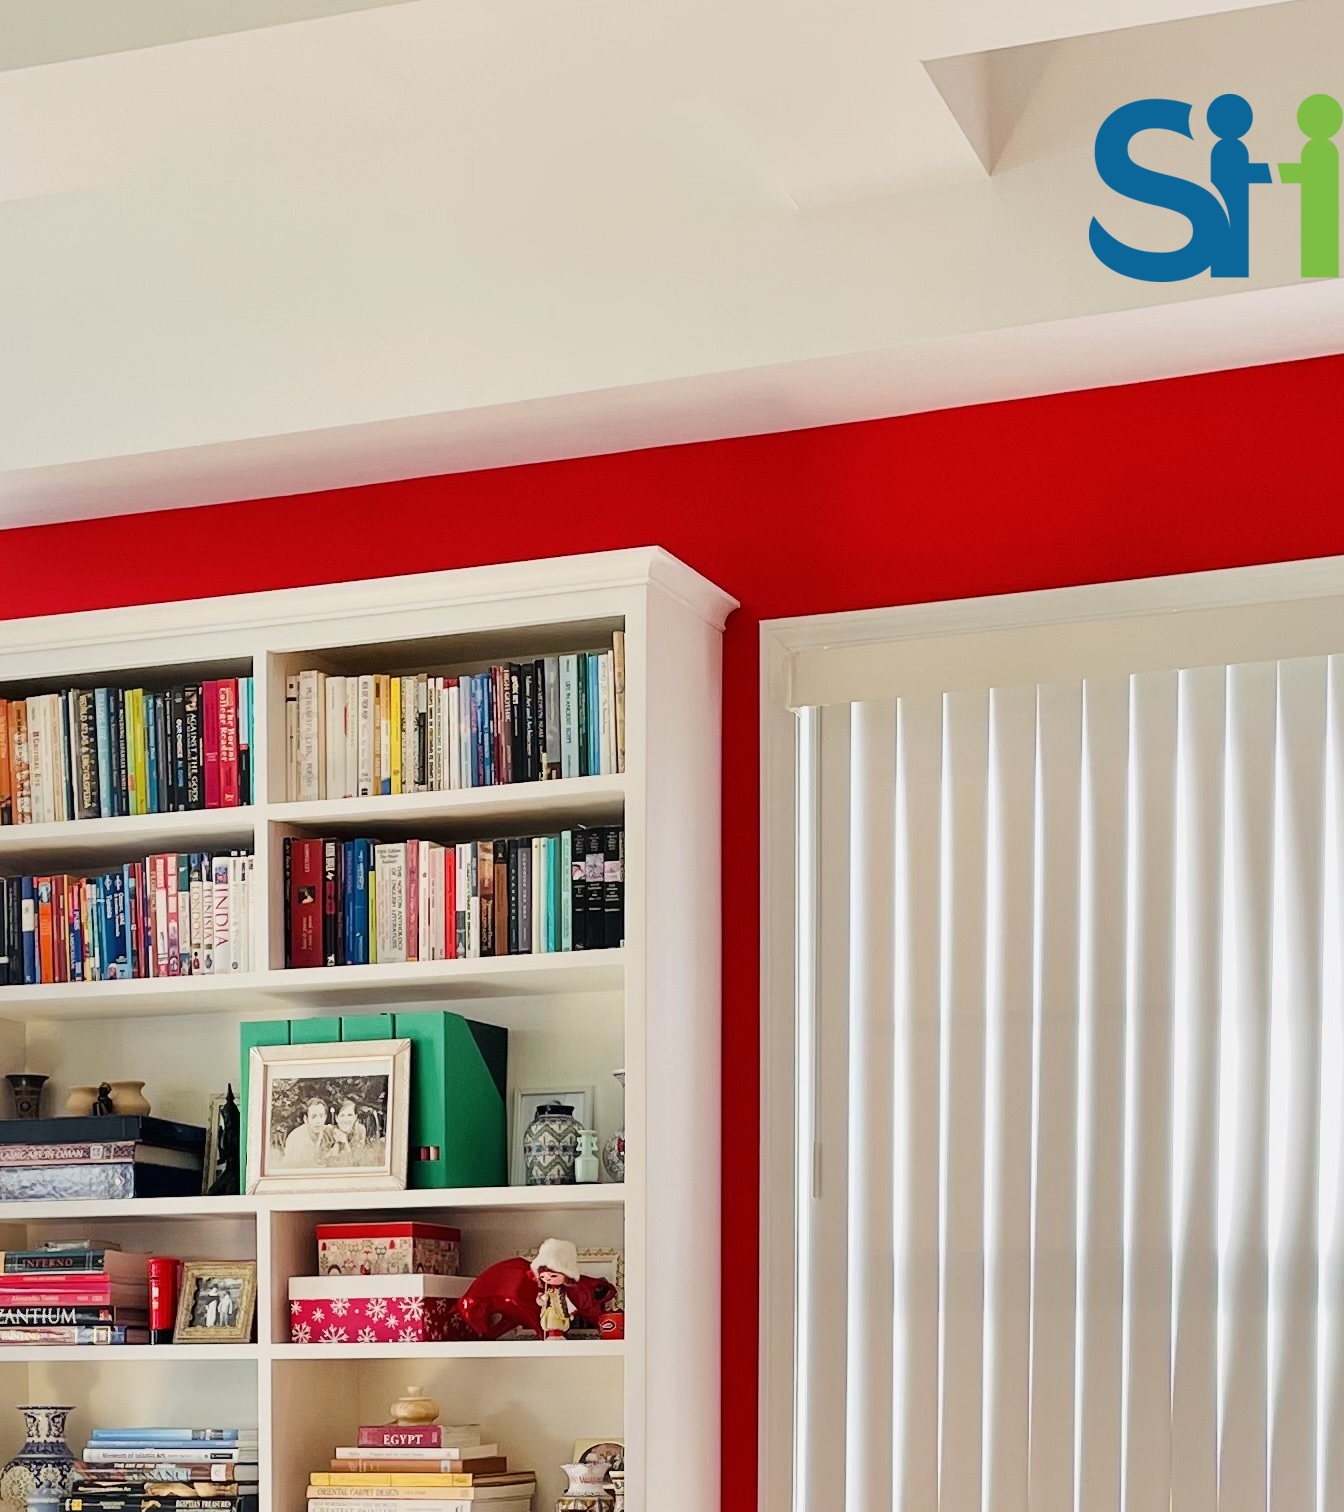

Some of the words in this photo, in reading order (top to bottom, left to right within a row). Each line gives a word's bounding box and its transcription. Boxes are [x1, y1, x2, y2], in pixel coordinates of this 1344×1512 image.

[191, 885, 202, 943] LONDON
[203, 887, 213, 941] TUNISIA
[215, 888, 229, 947] INDIA
[56, 1149, 84, 1159] OMAN
[383, 1434, 424, 1445] EGYPT
[316, 1488, 348, 1496] ORIENTAL
[349, 1487, 374, 1496] CARPET
[375, 1487, 399, 1496] DESIGN
